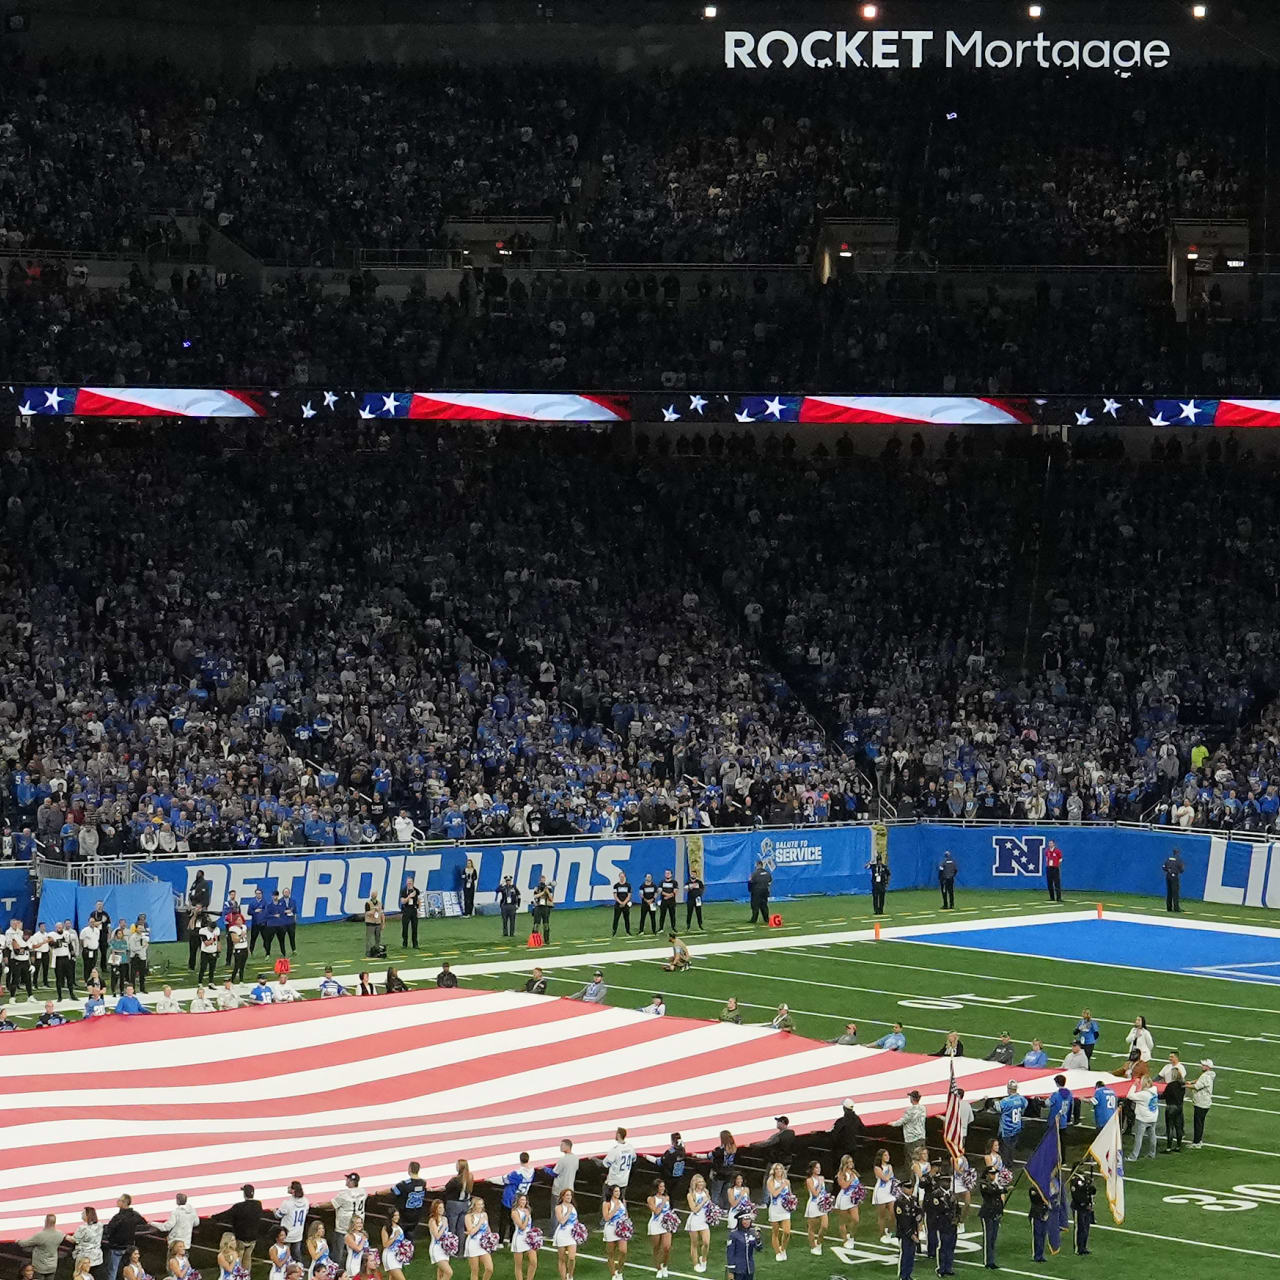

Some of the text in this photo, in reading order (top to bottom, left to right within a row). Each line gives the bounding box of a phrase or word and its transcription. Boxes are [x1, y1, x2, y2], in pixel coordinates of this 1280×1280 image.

[724, 30, 934, 69] ROCKET
[775, 846, 823, 862] SERVICE
[465, 844, 633, 908] LIONS
[619, 1151, 632, 1172] 24
